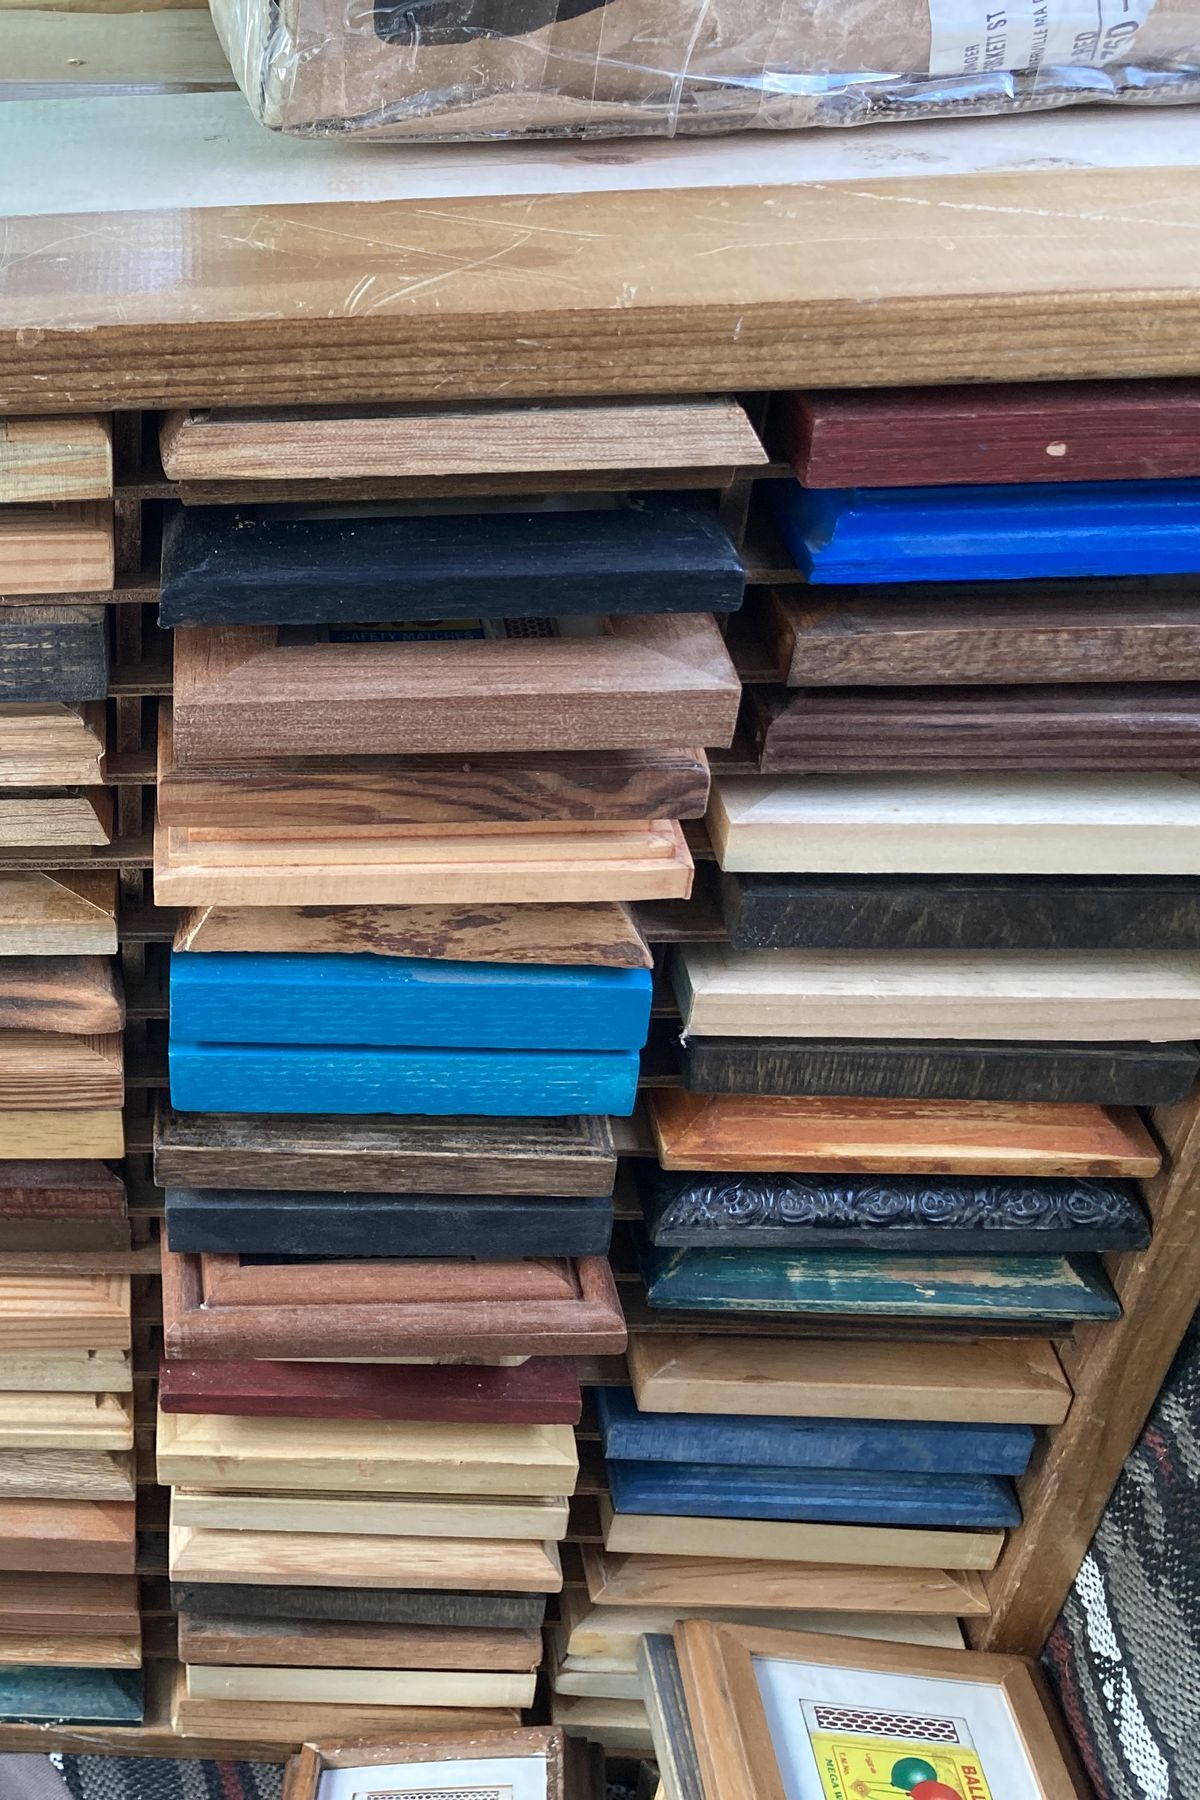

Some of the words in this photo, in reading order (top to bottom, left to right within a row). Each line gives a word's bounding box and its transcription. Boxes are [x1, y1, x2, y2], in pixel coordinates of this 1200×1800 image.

[987, 9, 1008, 30] ST
[341, 632, 396, 642] SAFETY
[402, 631, 474, 641] MATCHES
[825, 1758, 840, 1789] MEGA
